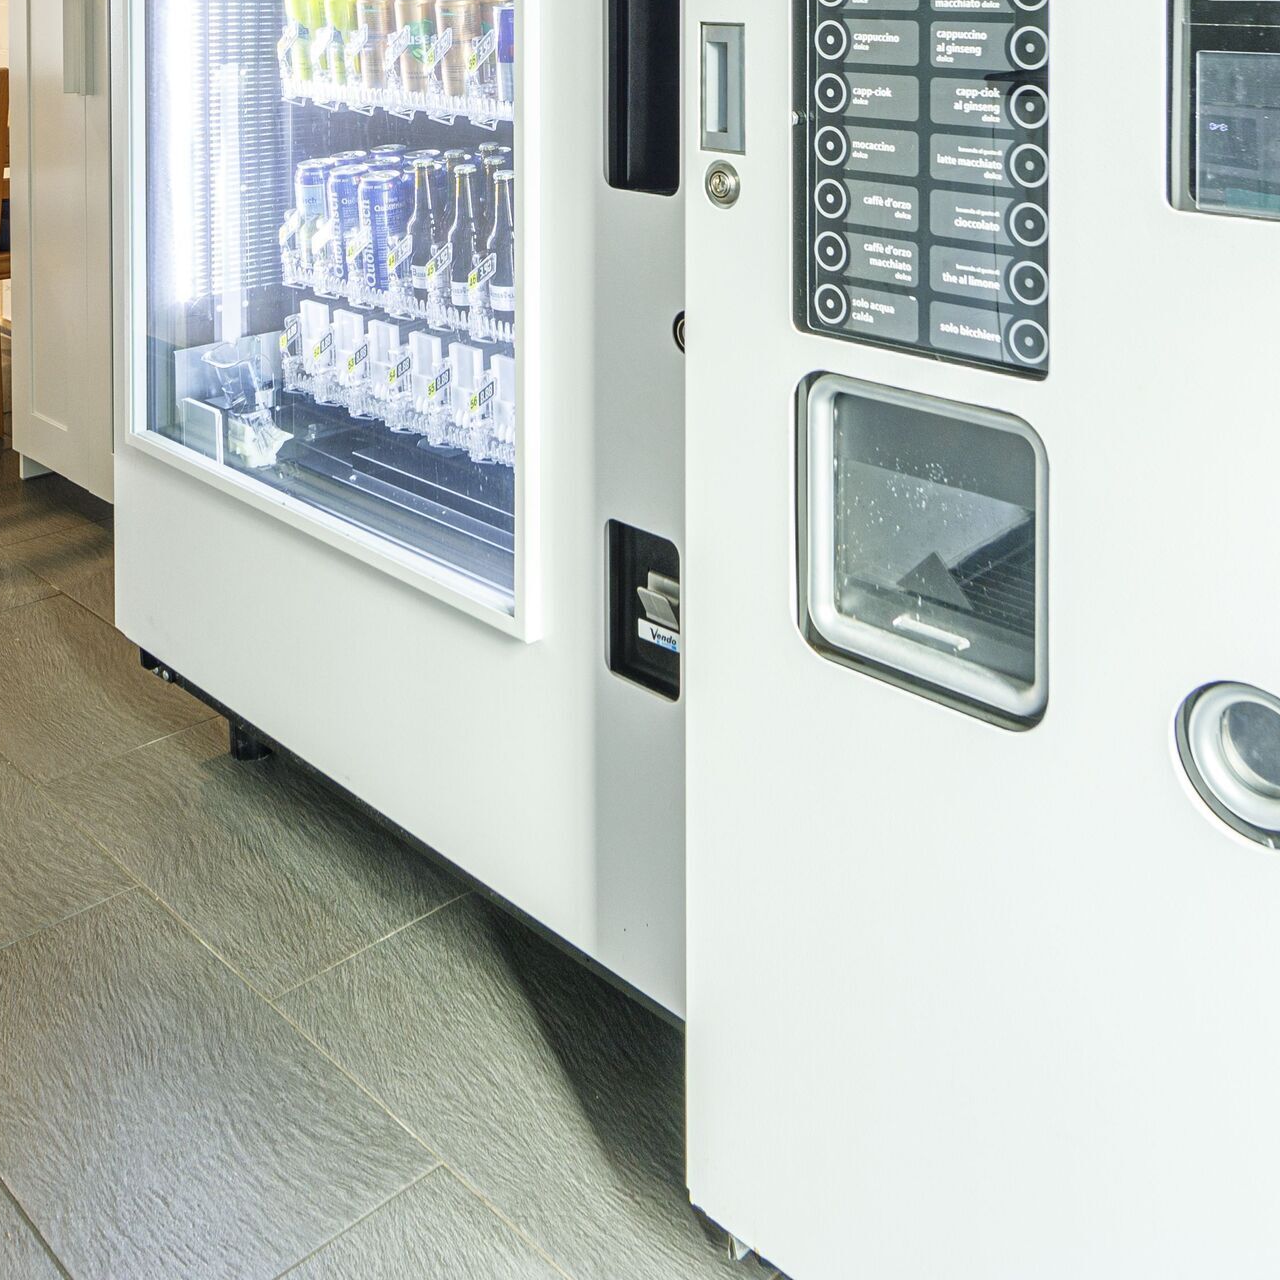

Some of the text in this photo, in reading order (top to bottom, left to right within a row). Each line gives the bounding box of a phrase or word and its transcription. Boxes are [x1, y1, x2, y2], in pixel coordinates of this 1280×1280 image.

[854, 32, 899, 44] cappuccino
[937, 29, 987, 42] cappuccino
[937, 43, 981, 56] al ginseng
[853, 86, 891, 99] capp-ciok
[956, 87, 1000, 100] capp-ciok
[954, 101, 1000, 114] al ginseng
[853, 140, 895, 154] mocaccino
[937, 155, 1002, 170] latte macchiato
[864, 195, 883, 207] caffè
[954, 216, 1000, 232] cioccolato
[864, 242, 883, 254] caffè
[870, 256, 911, 272] macchiato
[943, 271, 1000, 291] the al limone
[852, 297, 894, 315] solo acqua
[852, 310, 873, 323] calda
[940, 321, 1001, 343] solo bicchiere
[650, 627, 677, 646] Vendo
